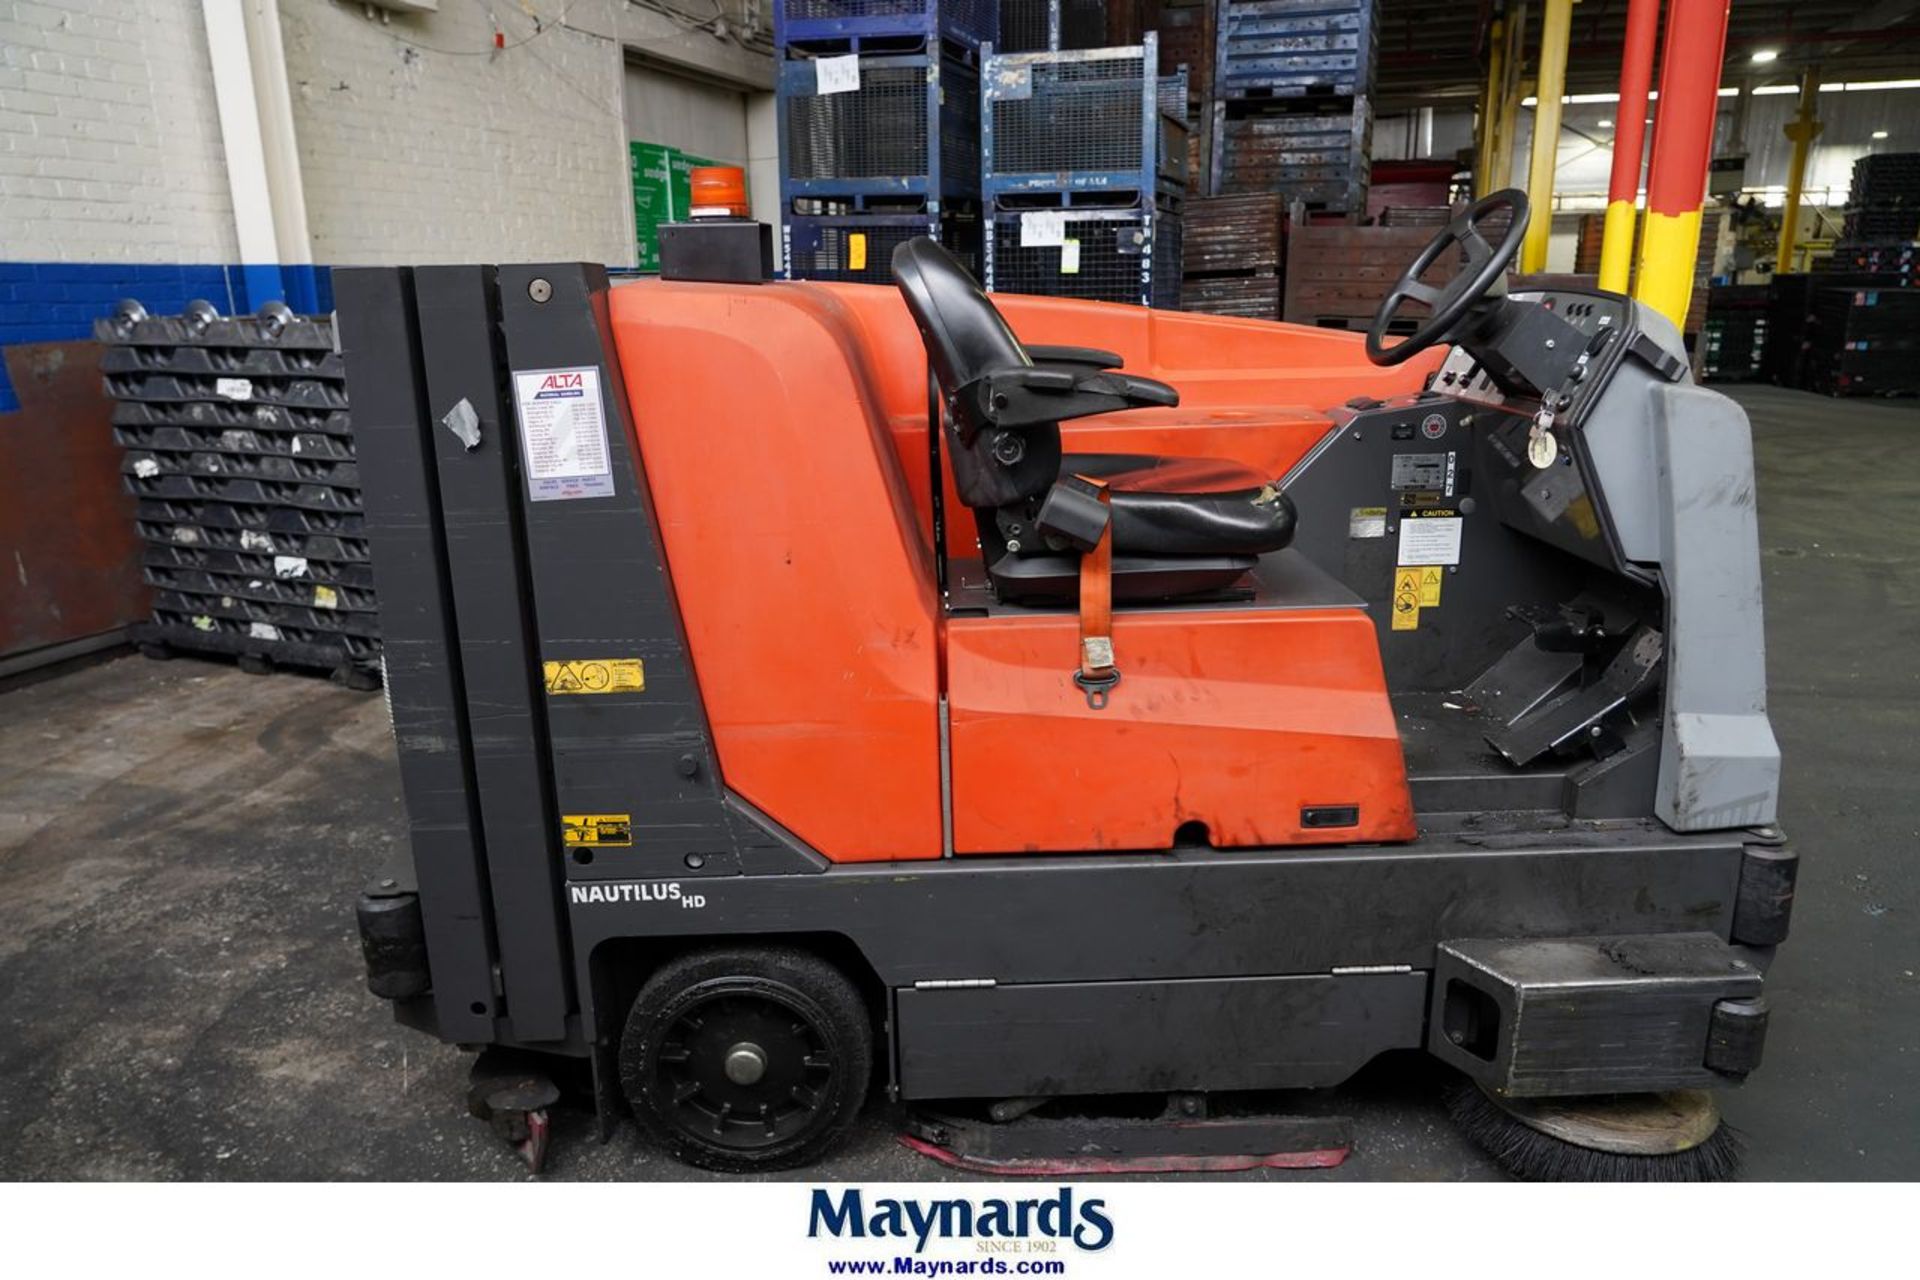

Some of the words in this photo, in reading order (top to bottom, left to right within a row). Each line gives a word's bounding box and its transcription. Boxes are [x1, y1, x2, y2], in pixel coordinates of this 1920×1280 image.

[541, 374, 583, 389] ALTA
[1422, 509, 1454, 517] CAUTION
[572, 883, 681, 904] NAUTILUS
[682, 895, 706, 908] HD
